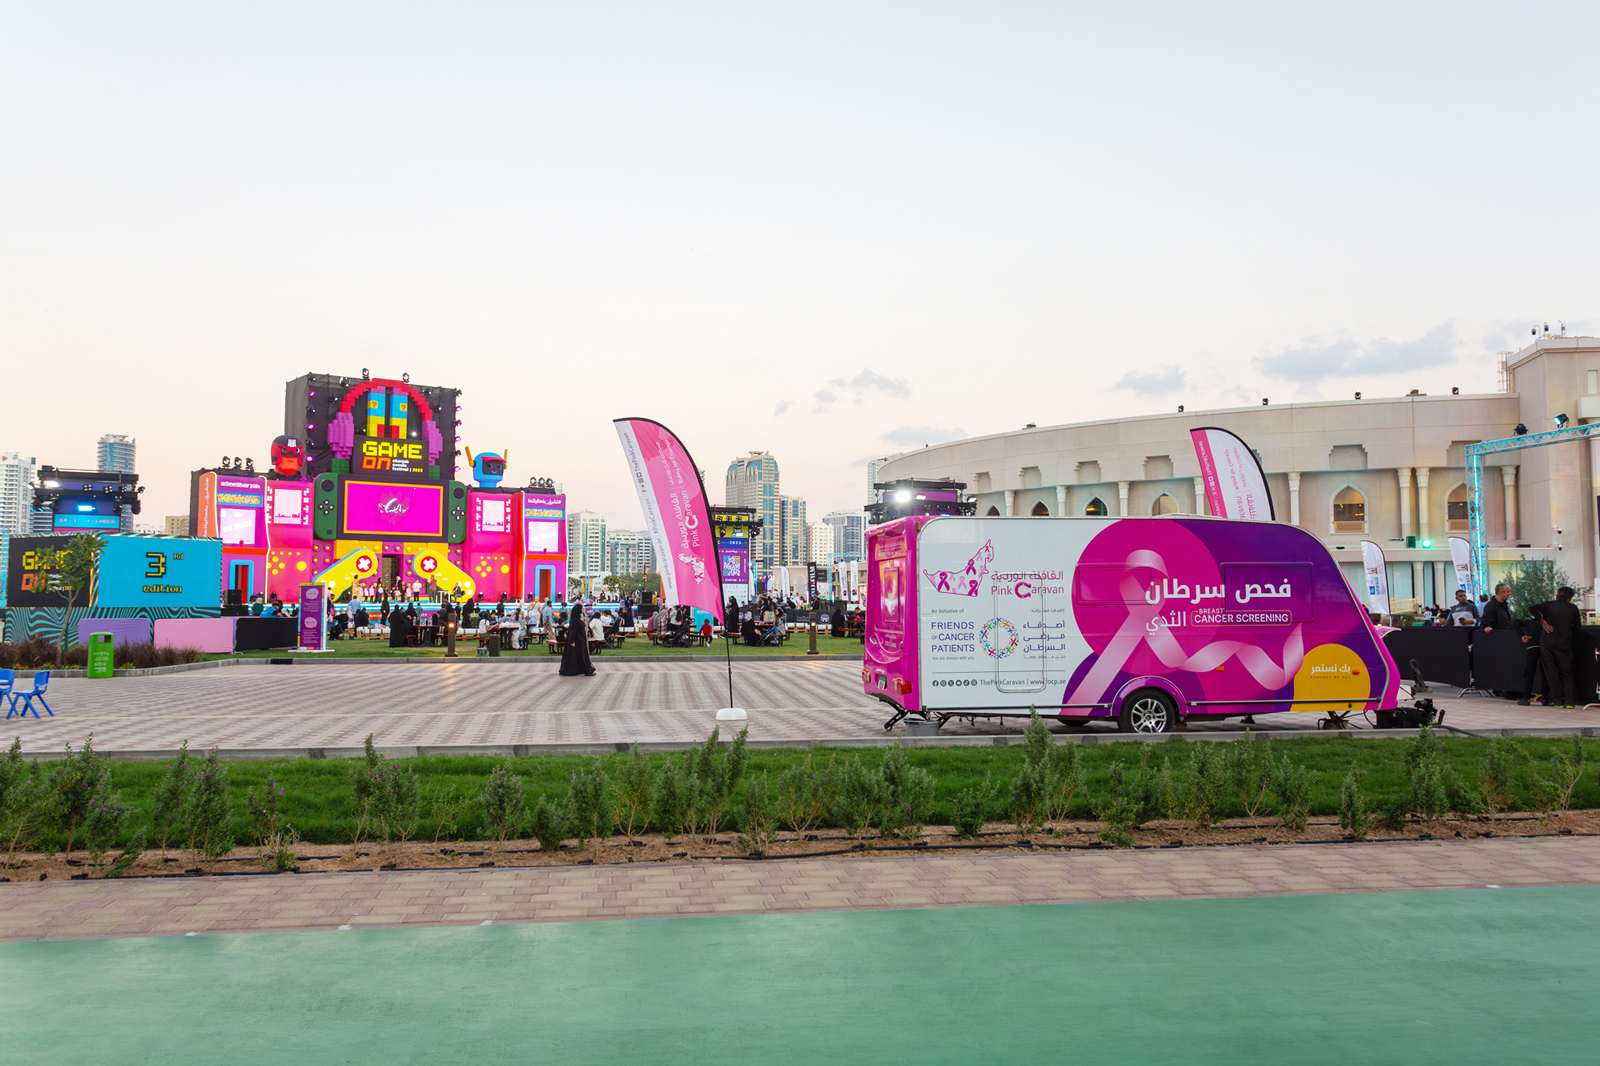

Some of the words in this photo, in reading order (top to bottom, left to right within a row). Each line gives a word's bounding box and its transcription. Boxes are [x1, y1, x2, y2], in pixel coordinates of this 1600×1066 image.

[362, 440, 423, 460] GAME
[623, 432, 641, 472] ThePinkCaravan
[681, 489, 699, 530] Caravan
[670, 492, 683, 520] القافلة
[678, 522, 690, 549] الوردية
[690, 529, 701, 548] Pink
[145, 552, 167, 578] 3
[991, 571, 1026, 582] الوردية
[1029, 571, 1064, 581] القافلة
[142, 584, 183, 593] edition
[991, 585, 1012, 596] Pink
[1014, 581, 1065, 599] Caravan
[1145, 578, 1226, 605] سرطان
[1235, 578, 1291, 604] فحص
[1023, 619, 1066, 629] أصدقاء
[1146, 610, 1187, 636] الثدي
[1194, 614, 1234, 623] CANCER
[1235, 613, 1289, 622] SCREENING
[931, 621, 975, 630] FRIENDS
[938, 632, 975, 641] CANCER
[1022, 632, 1066, 642] مرضى
[931, 644, 975, 653] PATIENTS
[1023, 643, 1066, 653] السرطان
[1310, 663, 1338, 675] نستمر
[1339, 663, 1351, 675] بك
